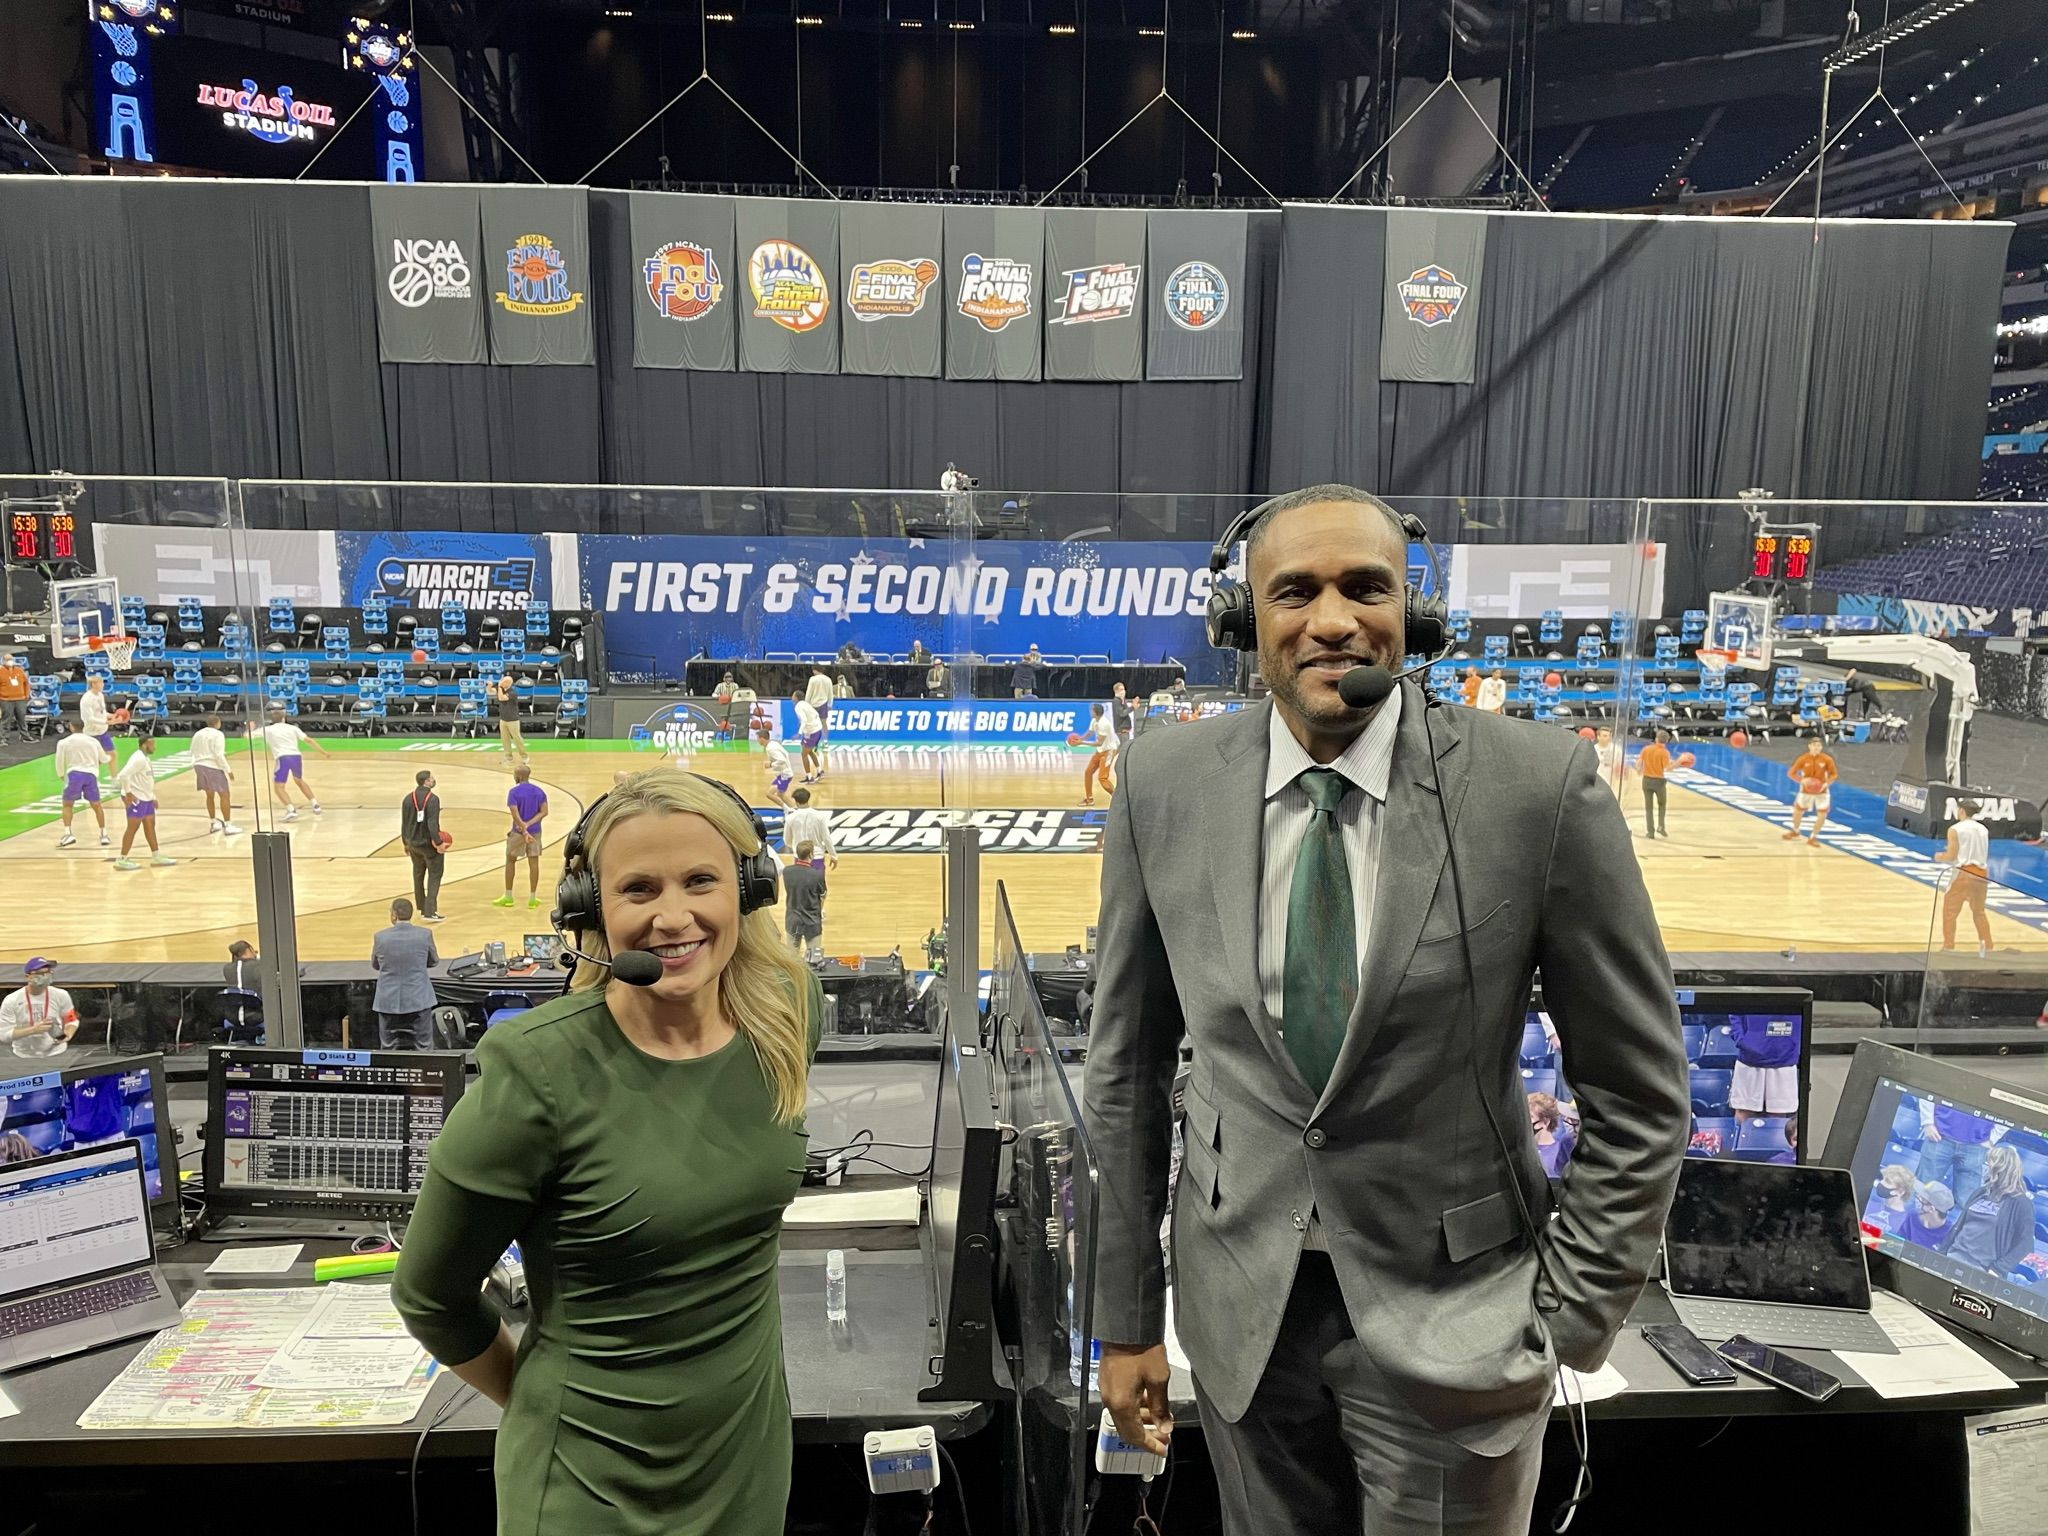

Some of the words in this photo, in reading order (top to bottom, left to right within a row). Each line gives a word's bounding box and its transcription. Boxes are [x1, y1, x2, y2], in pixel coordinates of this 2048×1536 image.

[235, 4, 291, 24] STADIUM
[197, 84, 285, 116] LUCAS
[290, 100, 335, 126] OIL
[223, 112, 314, 140] STADIUM
[523, 236, 545, 246] 1991
[656, 242, 673, 257] 1997
[675, 241, 701, 252] NCAA
[393, 239, 466, 264] NCAA
[507, 246, 565, 268] FINAL
[871, 273, 917, 286] FINAL
[980, 261, 1029, 282] FINAL
[1088, 270, 1134, 289] FINAL
[507, 269, 571, 304] FOUR
[773, 285, 822, 302] Final
[856, 285, 916, 300] FOUR
[961, 274, 1029, 303] FOUR
[1178, 281, 1215, 294] FINAL
[1403, 284, 1431, 297] FINAL
[1433, 286, 1461, 298] FOUR
[510, 304, 570, 313] INDIANAPOLIS
[759, 295, 804, 312] Four
[858, 304, 911, 312] INDIANAPOLIS
[967, 303, 1023, 315] INDIANAPOLIS
[1179, 297, 1214, 312] FOUR
[671, 306, 714, 321] INDIANAPOLIS
[12, 516, 37, 531] 15:38
[16, 532, 36, 557] 30
[54, 532, 72, 557] 30
[1754, 552, 1771, 577] 30
[1787, 553, 1806, 577] 30
[384, 573, 405, 582] NCAA
[406, 564, 490, 590] MARCH
[605, 561, 753, 613] FIRST
[763, 563, 799, 613] &
[812, 563, 1010, 616] SECOND
[1019, 567, 1212, 618] ROUNDS
[666, 722, 681, 732] THE
[682, 722, 697, 732] BIG
[827, 710, 902, 732] ELCOME
[907, 710, 932, 731] TO
[936, 710, 970, 732] THE
[974, 711, 1008, 732] BIG
[1012, 711, 1076, 732] DANCE
[653, 731, 714, 748] DANCE
[220, 1051, 231, 1059] 4K
[1953, 1293, 1987, 1315] I-TECH
